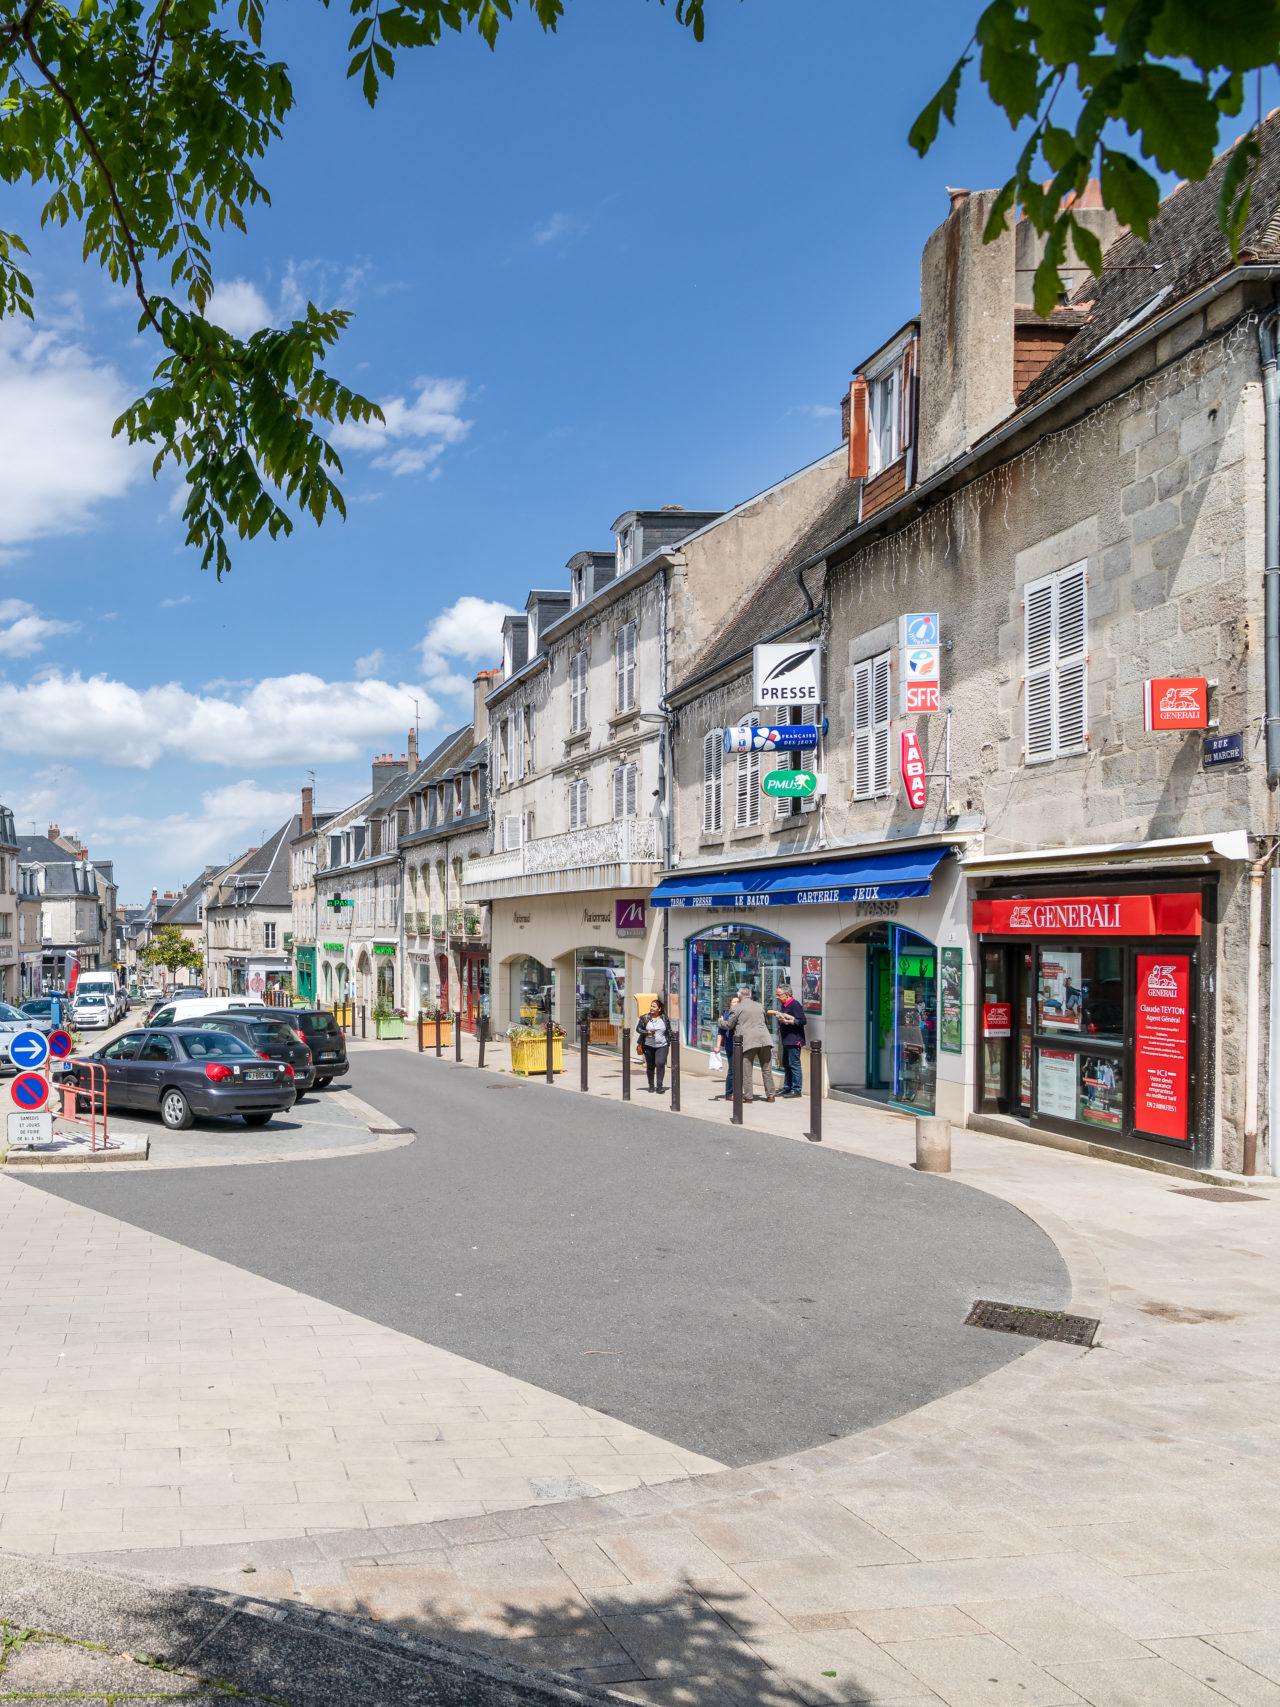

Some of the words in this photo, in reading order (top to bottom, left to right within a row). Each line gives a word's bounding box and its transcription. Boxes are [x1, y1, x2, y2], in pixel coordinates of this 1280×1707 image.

[761, 686, 816, 700] PRESSE
[907, 687, 939, 707] SFR
[1160, 711, 1200, 720] GENERALI
[781, 733, 816, 741] FRANÇAISE
[1213, 739, 1228, 749] RUE
[1204, 753, 1212, 763] DU
[1213, 747, 1239, 760] MARCHÉ
[904, 732, 924, 805] TABAC
[767, 779, 794, 790] PMU
[670, 898, 686, 907] TABAC
[692, 897, 713, 907] PRESSE
[735, 896, 744, 905] LE
[746, 895, 770, 905] BALTO
[797, 890, 840, 904] CARTERIE
[852, 887, 880, 900] JEUX
[1033, 904, 1121, 928] GENERALI
[1147, 989, 1178, 998] GENERALI
[1140, 1005, 1161, 1013] Claude
[1160, 1006, 1185, 1015] TEYTON
[1161, 1015, 1181, 1024] Général
[1157, 1069, 1168, 1077] ICI
